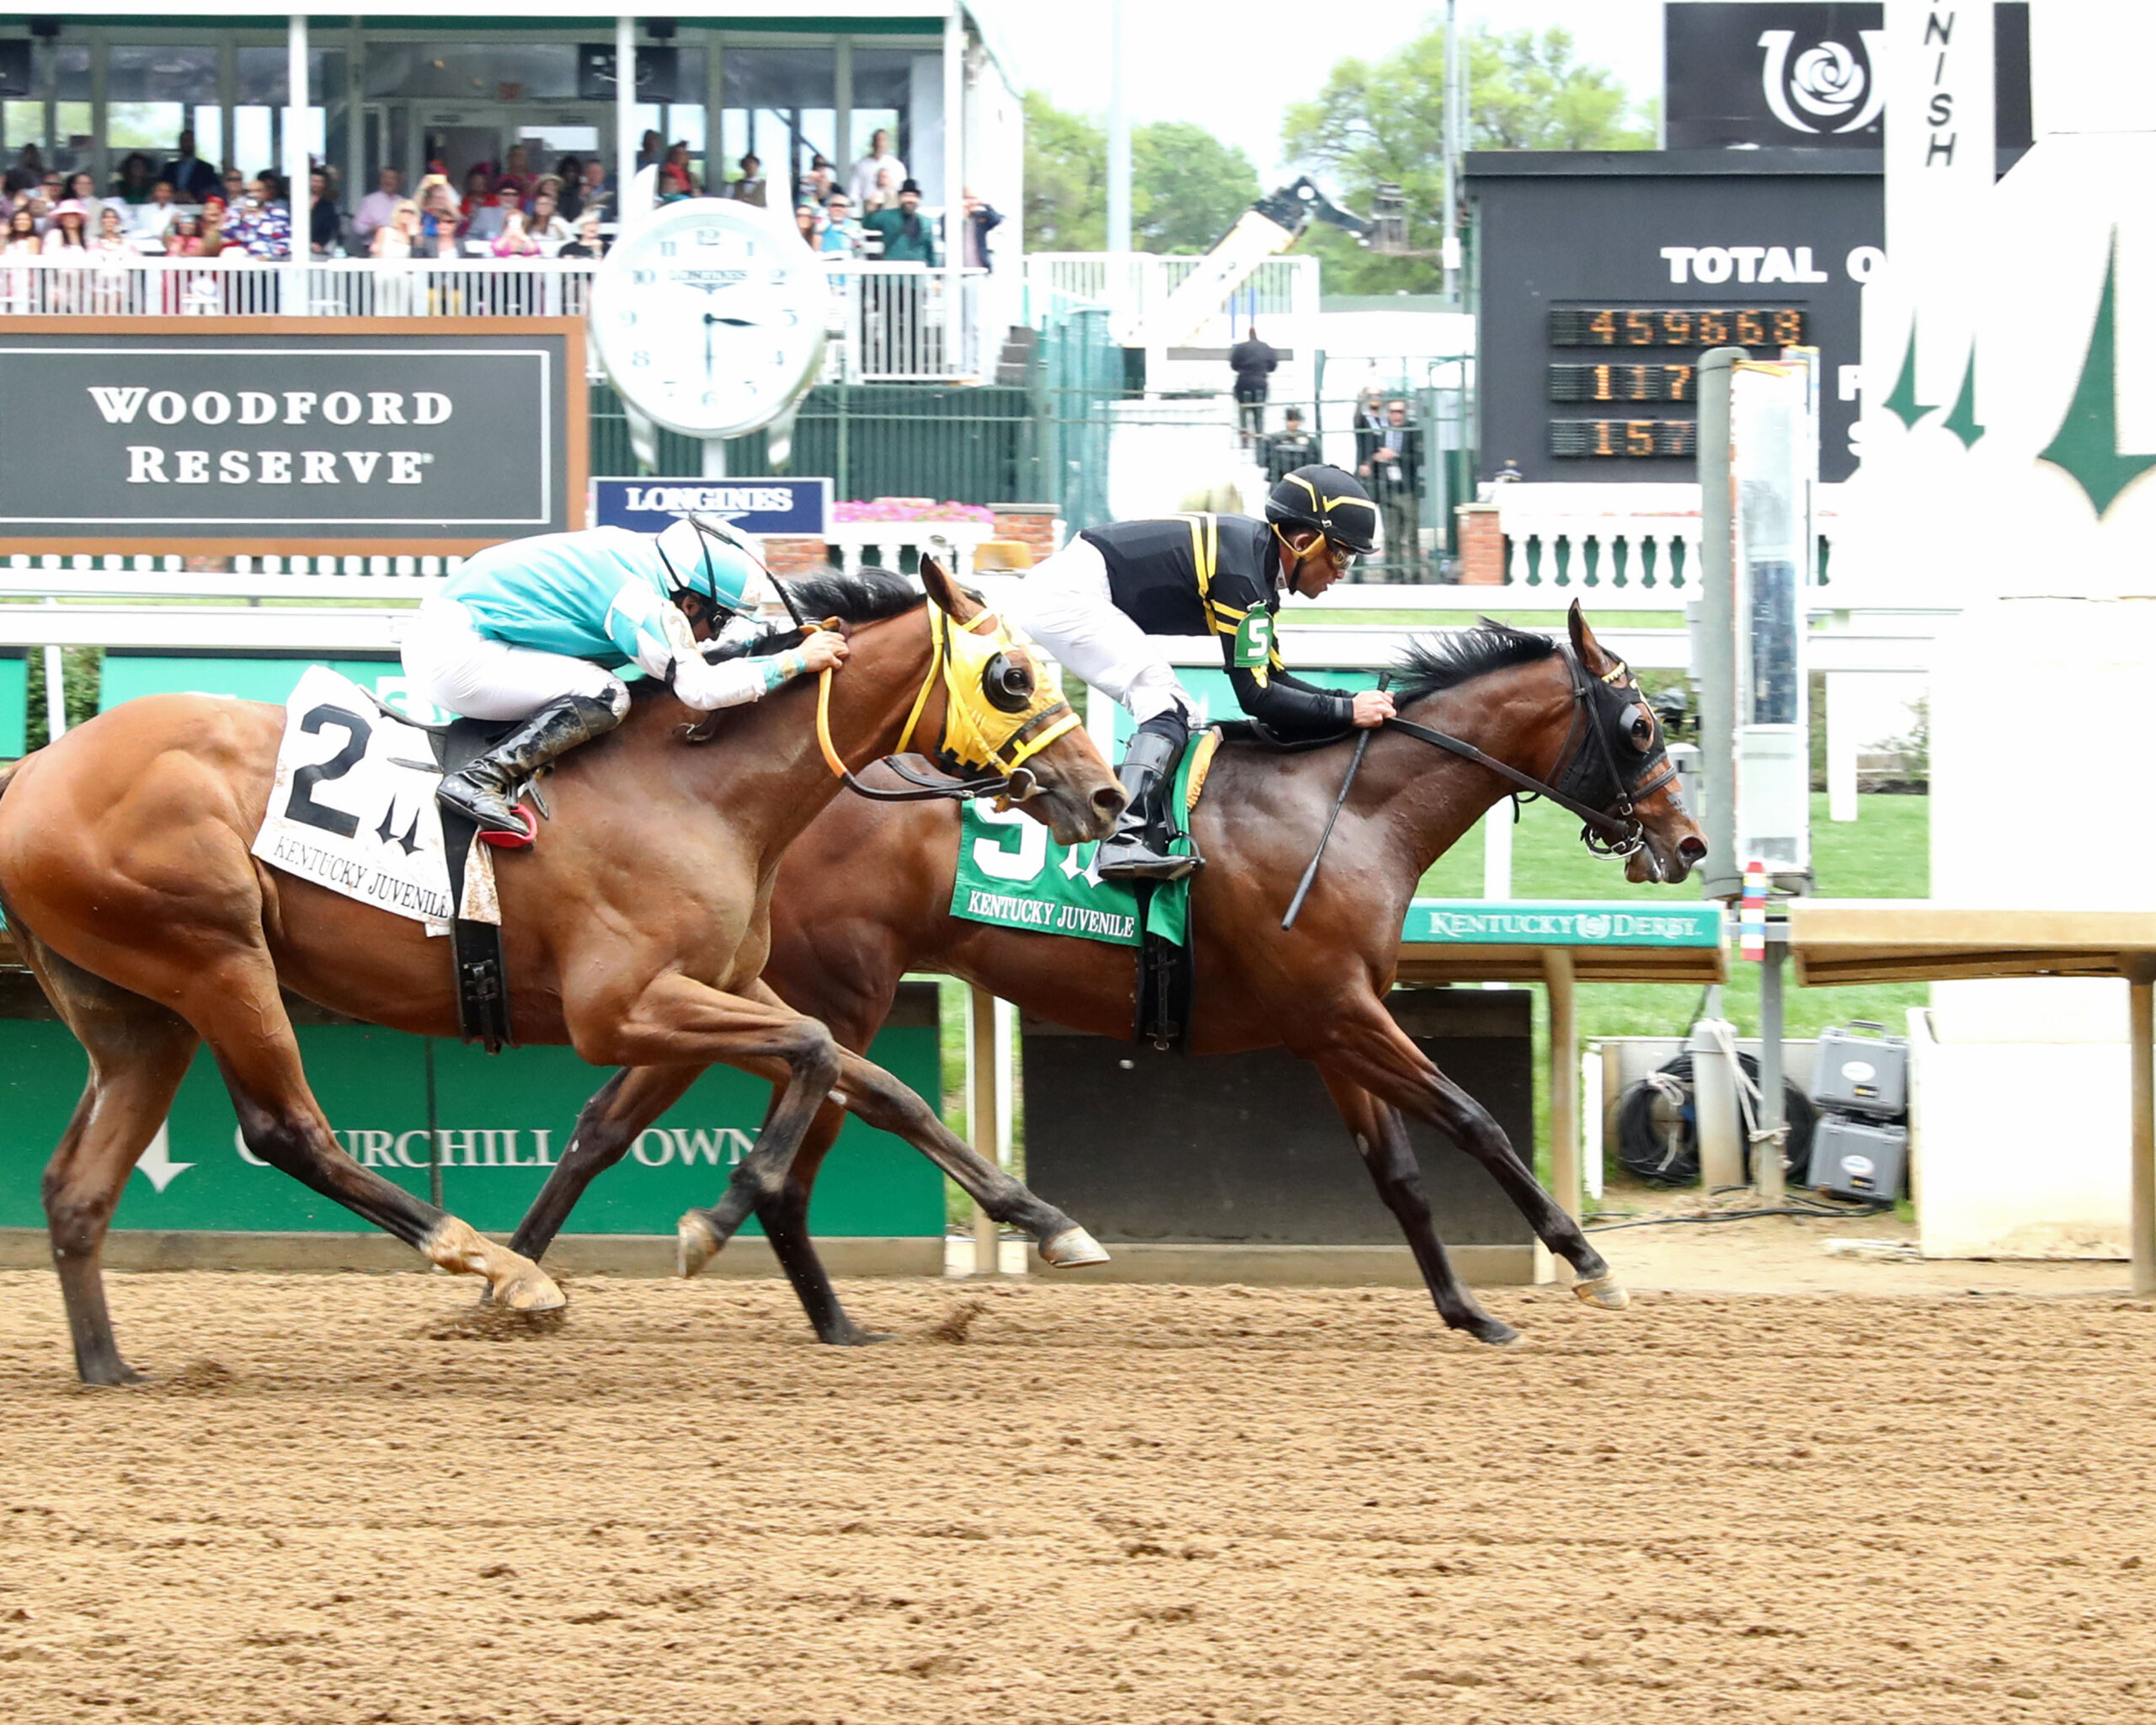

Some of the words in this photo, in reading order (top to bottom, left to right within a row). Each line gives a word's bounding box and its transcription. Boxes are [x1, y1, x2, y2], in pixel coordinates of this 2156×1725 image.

[1923, 0, 1958, 168] NISH
[1660, 246, 1828, 284] TOTAL
[87, 387, 454, 425] WOODFORD
[625, 486, 794, 512] LONGINES
[1247, 617, 1269, 657] 5
[284, 702, 373, 839] 2
[972, 797, 1049, 882] 5
[273, 836, 369, 889] KENTUCKY
[367, 872, 450, 919] JUVENILE
[967, 889, 1056, 926] KENTUCKY
[1056, 905, 1135, 938] JUVENILE
[1428, 911, 1577, 938] KENTUCKY
[1612, 913, 1700, 940] DERBY
